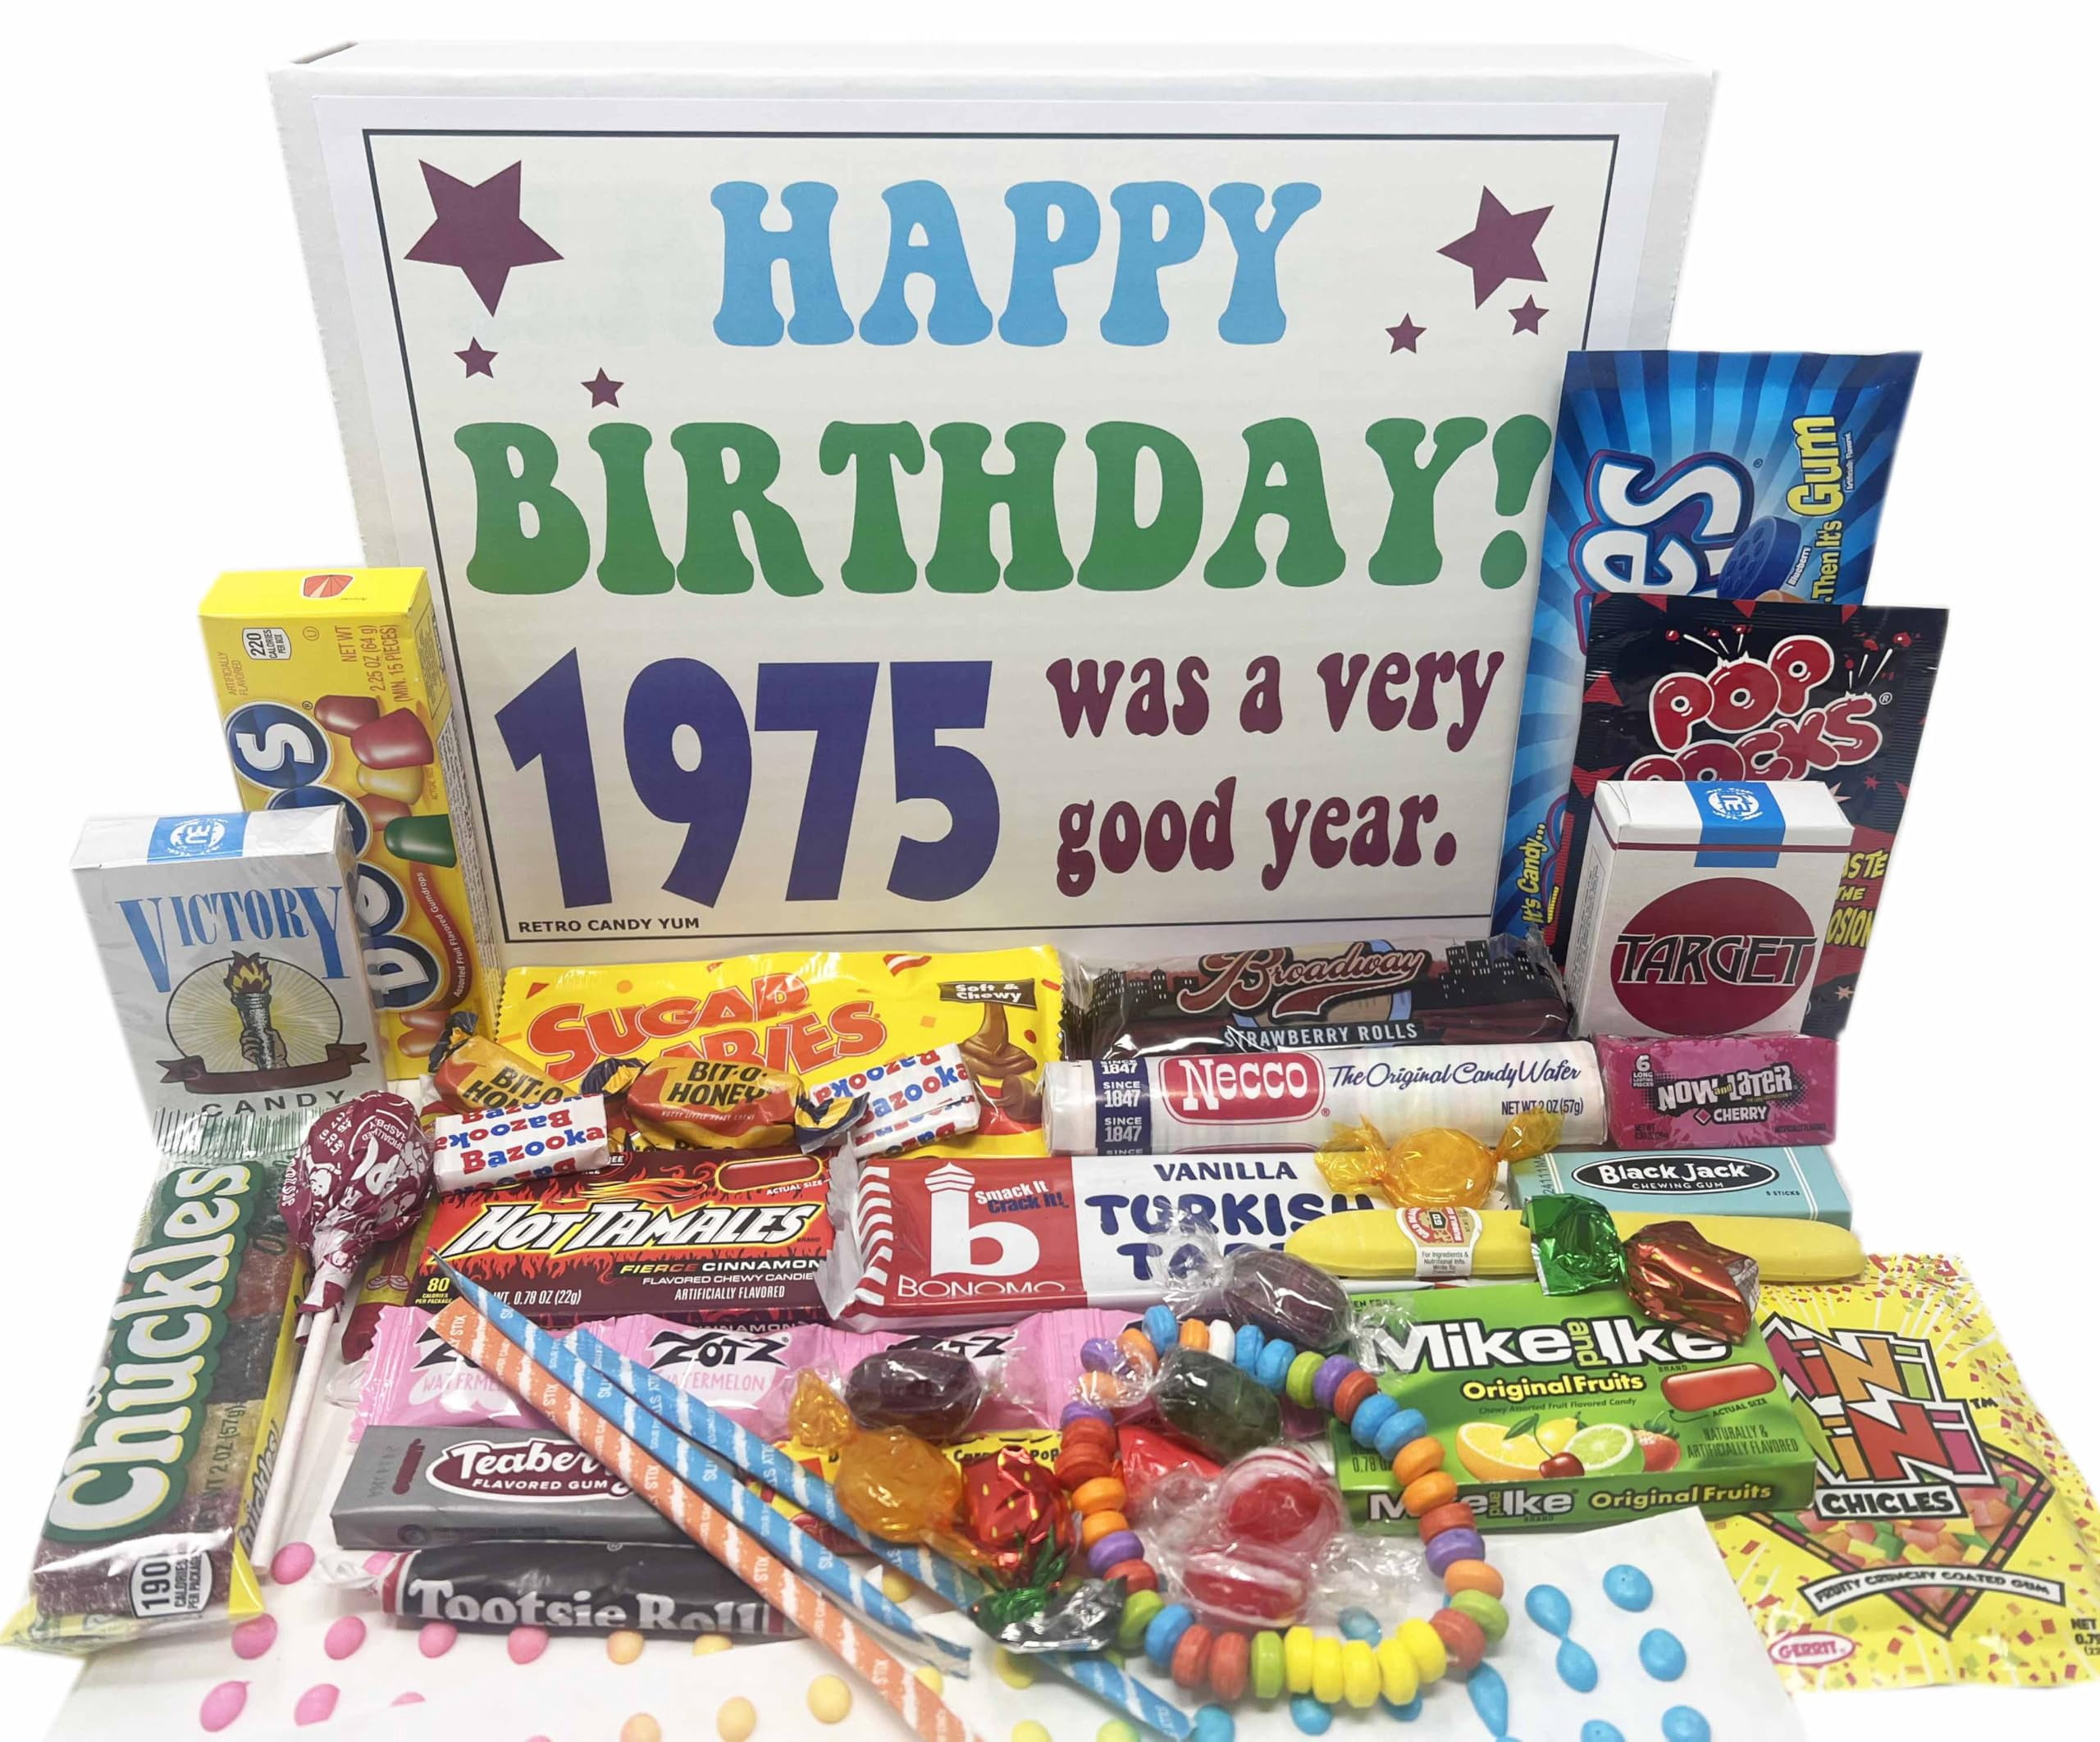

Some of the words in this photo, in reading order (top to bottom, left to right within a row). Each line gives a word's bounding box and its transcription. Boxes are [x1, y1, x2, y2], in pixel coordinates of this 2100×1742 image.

[710, 180, 1322, 346] HAPPY
[1787, 416, 1845, 516] Gum
[454, 413, 1551, 596] BIRTHDAY!
[1815, 520, 1844, 549] It's
[249, 632, 267, 657] 220
[268, 629, 278, 659] CALORIES
[335, 625, 353, 640] WT
[380, 624, 401, 661] PIECES)
[341, 642, 358, 663] NET
[360, 636, 379, 654] (64
[217, 651, 236, 696] ARTIFICIALLY
[363, 655, 381, 668] OZ
[388, 663, 404, 676] 15
[232, 659, 249, 696] FLAVORED
[367, 669, 386, 692] 2.25
[390, 677, 410, 703] (MIN.
[1046, 654, 1210, 739] was
[1239, 654, 1284, 736] a
[1317, 649, 1504, 752] very
[1649, 635, 1835, 753] POP
[494, 647, 1001, 910] 1975
[1056, 776, 1237, 898] good
[1262, 796, 1457, 891] year.
[416, 871, 440, 914] Gumdrops
[1521, 896, 1536, 923] It's
[435, 914, 460, 945] Flavored
[518, 919, 582, 933] RETRO
[586, 919, 653, 933] CANDY
[657, 917, 701, 931] YUM
[115, 886, 351, 994] VICTORY
[450, 941, 464, 961] Fruit
[1615, 934, 1817, 985] TARGET
[454, 961, 467, 998] Assorted
[954, 983, 995, 992] Soft
[1003, 983, 1020, 991] &
[1178, 948, 1425, 1017] Broadway
[955, 992, 1022, 1003] Chewy
[1224, 1026, 1349, 1048] STRAWBERRY
[1358, 1022, 1418, 1042] ROLLS
[1101, 1063, 1138, 1075] 1847
[1329, 1065, 1366, 1087] The
[1365, 1063, 1452, 1090] Original
[1451, 1065, 1518, 1089] Candy
[1518, 1060, 1582, 1082] Wafer
[1636, 1055, 1650, 1071] 6
[666, 1083, 768, 1106] HONEY
[1102, 1081, 1141, 1089] SINCE
[1181, 1058, 1308, 1110] Necco
[1657, 1078, 1719, 1112] NOW
[1713, 1083, 1733, 1096] and
[202, 1090, 346, 1117] CANDY
[1104, 1090, 1141, 1108] 1847
[1501, 1101, 1520, 1115] NET
[1521, 1101, 1536, 1115] WT
[1546, 1099, 1560, 1114] OZ
[1559, 1097, 1584, 1117] (57g)
[1104, 1117, 1143, 1126] SINCE
[1713, 1106, 1767, 1122] CHERRY
[435, 1109, 573, 1151] Bazooka
[1104, 1126, 1143, 1142] 1847
[460, 1127, 605, 1174] Bazooka
[1153, 1161, 1298, 1182] VANILLA
[1598, 1162, 1680, 1186] Black
[1682, 1163, 1750, 1188] Jack
[766, 1183, 802, 1196] ACTUAL
[802, 1179, 823, 1189] SIZE
[975, 1183, 1034, 1205] Smack
[1033, 1180, 1049, 1193] It
[1632, 1182, 1692, 1190] CHEWING
[1696, 1181, 1724, 1189] GUM
[988, 1194, 1041, 1214] Crack
[440, 1205, 590, 1258] HOT
[556, 1202, 822, 1253] TAMALES
[619, 1263, 697, 1275] FIERCE
[701, 1259, 820, 1272] CINNAMON
[1431, 1251, 1463, 1259] Ingredients
[427, 1277, 450, 1293] 80
[642, 1276, 711, 1285] FLAVORED
[713, 1274, 767, 1284] CHEWY
[897, 1275, 1066, 1298] BONOMO
[514, 1290, 536, 1306] 0.78
[538, 1290, 552, 1305] OZ
[554, 1289, 582, 1306] (22g)
[674, 1286, 737, 1302] ARTIFICIALLY
[738, 1284, 785, 1300] FLAVORED
[450, 1314, 468, 1336] STIX
[48, 1165, 250, 1530] Chuckles
[647, 1330, 789, 1370] ZOTZ
[1362, 1319, 1573, 1372] Mike
[1568, 1320, 1609, 1368] and
[1591, 1319, 1727, 1365] Ike
[1658, 1365, 1688, 1373] BRAND
[543, 1383, 559, 1406] STIX
[1462, 1375, 1573, 1402] Original
[1576, 1372, 1645, 1393] Fruits
[1479, 1406, 1507, 1416] Chewy
[1509, 1404, 1546, 1413] Assorted
[1547, 1402, 1568, 1411] Fruit
[1570, 1399, 1608, 1409] Flavored
[1609, 1397, 1637, 1408] Candy
[1712, 1404, 1745, 1418] ACTUAL
[1746, 1398, 1769, 1410] SIZE
[220, 1402, 246, 1441] (57g)
[1703, 1426, 1759, 1440] NATURALLY
[1760, 1425, 1768, 1437] &
[213, 1442, 231, 1462] OZ
[1687, 1443, 1750, 1458] ARTIFICIALLY
[1751, 1438, 1799, 1454] FLAVORED
[208, 1465, 223, 1476] 2
[1352, 1457, 1376, 1473] 0.78
[472, 1478, 561, 1490] FLAVORED
[568, 1479, 608, 1490] GUM
[644, 1465, 660, 1490] STIX
[208, 1481, 224, 1503] WT
[1488, 1490, 1501, 1517] and
[1503, 1489, 1573, 1513] Ike
[1591, 1489, 1705, 1511] Original
[1705, 1483, 1772, 1501] Fruits
[1822, 1491, 1954, 1516] CHICLES
[754, 1556, 769, 1583] STIX
[140, 1560, 171, 1611] 190
[174, 1557, 189, 1608] CALORIES
[1814, 1579, 1861, 1603] FRUITY
[1865, 1571, 1937, 1585] CRUNCHY
[1941, 1571, 2006, 1585] COATED
[2011, 1579, 2051, 1594] GUM
[187, 1589, 200, 1610] PER
[408, 1579, 626, 1631] Tootsie
[636, 1592, 756, 1635] Roll
[2070, 1618, 2097, 1630] NET
[1778, 1639, 1838, 1658] GERRIT
